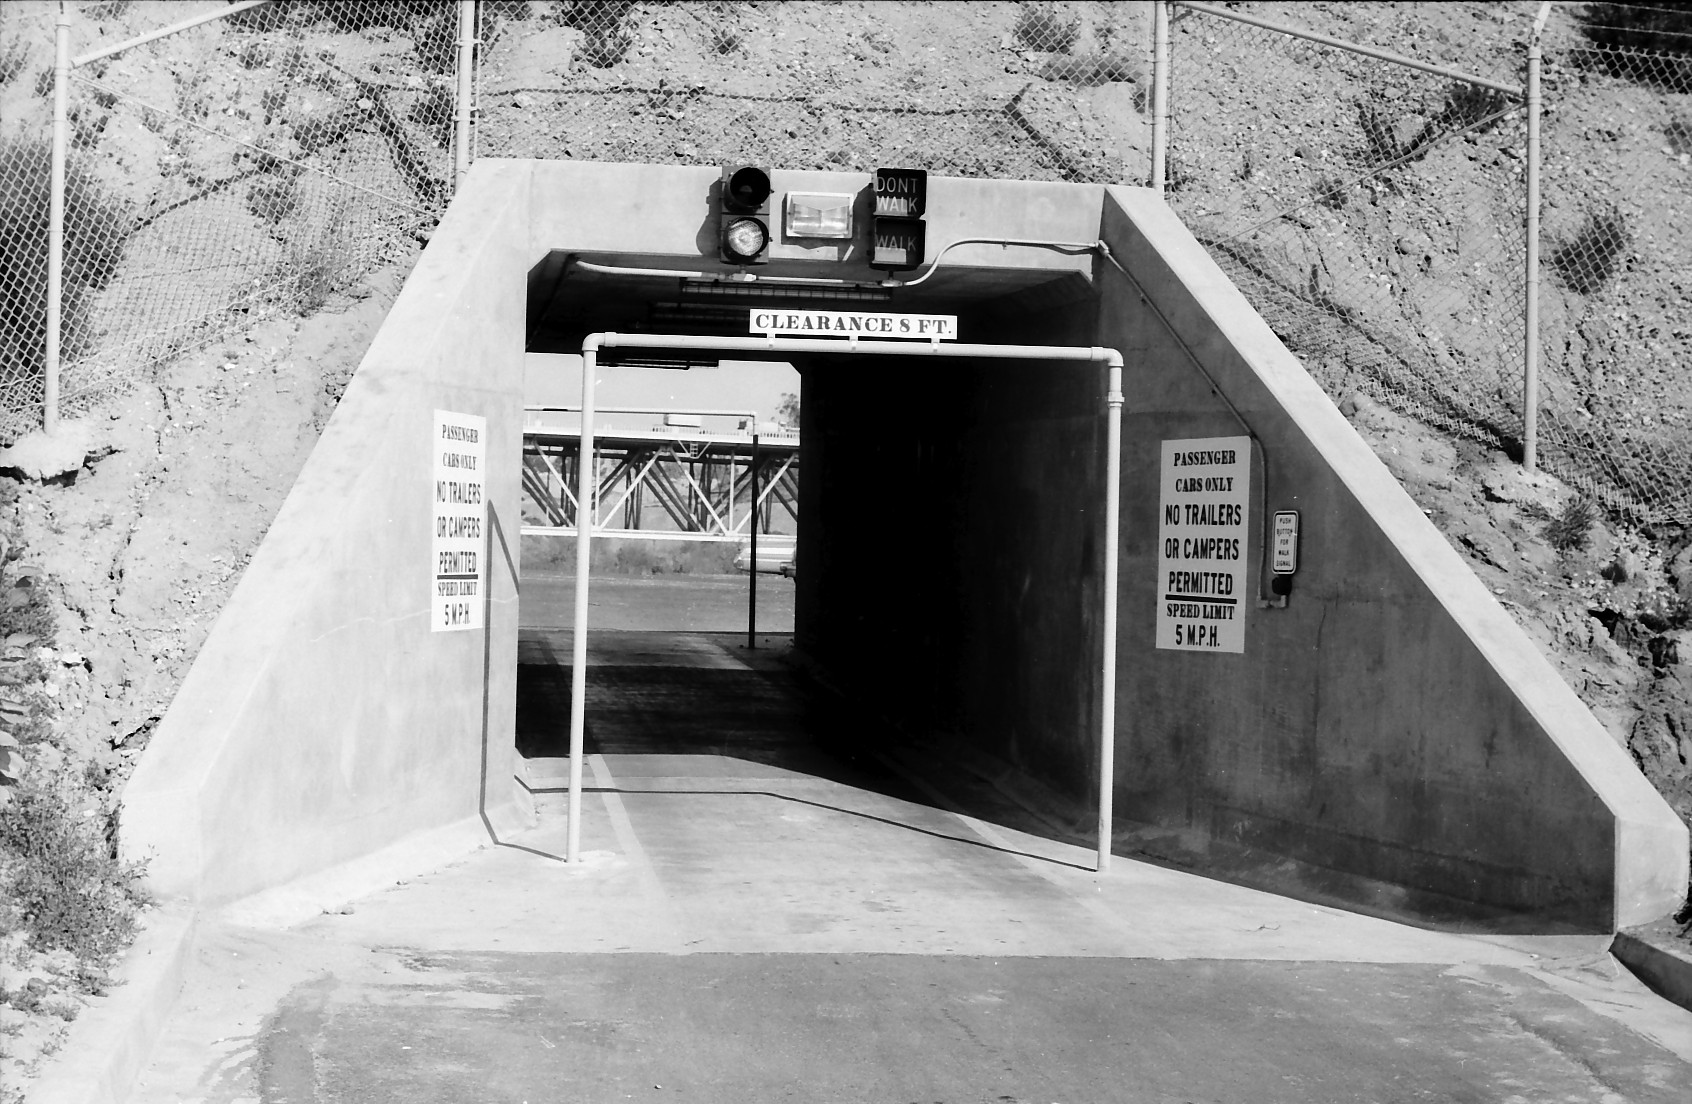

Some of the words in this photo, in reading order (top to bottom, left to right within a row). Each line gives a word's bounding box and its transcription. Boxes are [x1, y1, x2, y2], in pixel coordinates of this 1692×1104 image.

[876, 176, 919, 193] DONT
[876, 196, 918, 214] WALK
[875, 234, 917, 253] WALK
[755, 313, 893, 333] CLEARANCE
[899, 317, 911, 334] 8
[918, 319, 953, 335] FT.
[442, 424, 479, 444] PASSENGER
[442, 452, 460, 469] CARS
[460, 455, 477, 471] ONLY
[1173, 450, 1236, 467] PASSENGER
[436, 480, 446, 503] NO
[449, 481, 481, 505] TRAILERS
[1175, 477, 1203, 493] CARS
[1204, 477, 1234, 492] ONLY
[1165, 503, 1180, 526] NO
[1184, 503, 1242, 526] TRAILERS
[437, 516, 447, 538] OR
[448, 516, 481, 539] CAMPERS
[1165, 537, 1180, 559] OR
[1183, 537, 1239, 560] CAMPERS
[439, 550, 477, 573] PERMITTED
[437, 581, 459, 597] SPEED
[459, 581, 478, 596] LIMIT
[1168, 571, 1233, 596] PERMITTED
[444, 603, 450, 626] 5
[1166, 603, 1200, 618] SPEED
[1202, 604, 1235, 620] LIMIT
[1175, 624, 1183, 646] 5
[1186, 624, 1221, 648] M.P.H.
